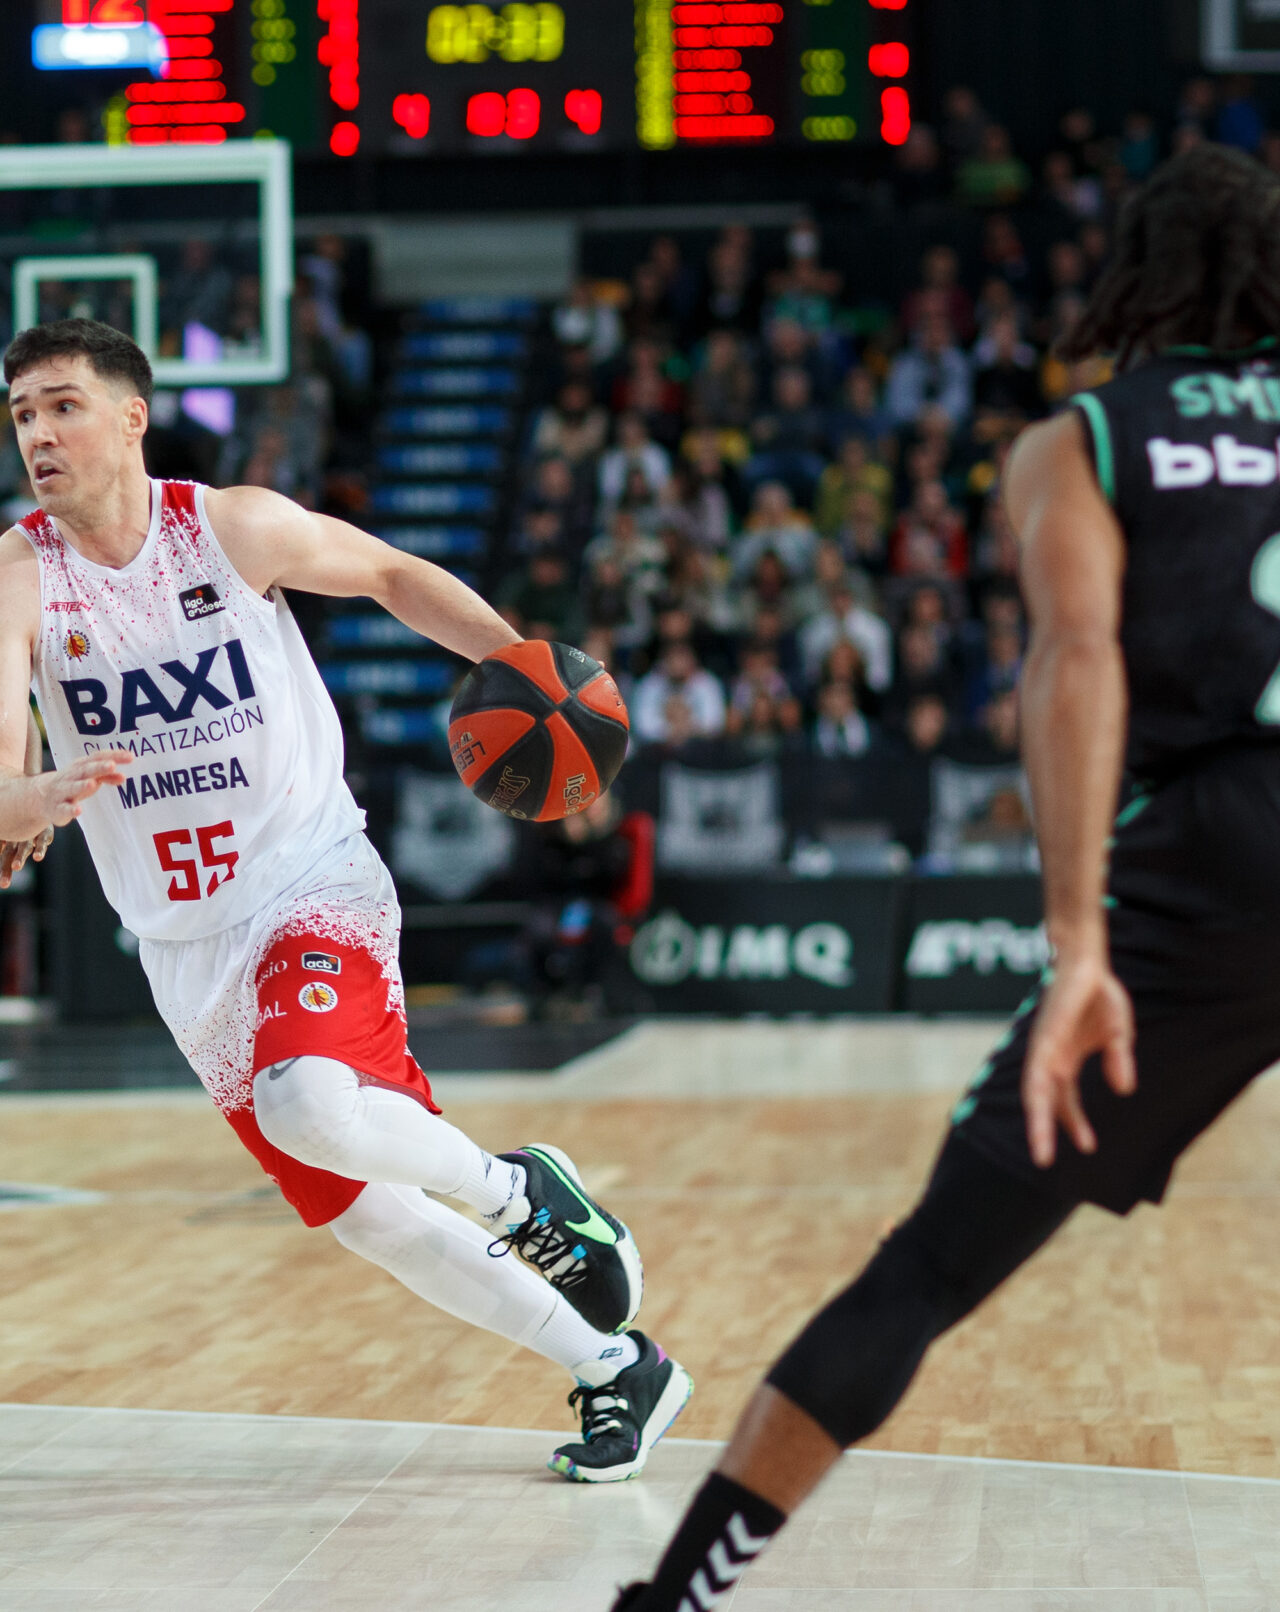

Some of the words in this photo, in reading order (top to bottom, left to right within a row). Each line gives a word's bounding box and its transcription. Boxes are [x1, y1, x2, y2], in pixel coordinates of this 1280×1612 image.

[1146, 434, 1280, 489] bb
[183, 596, 204, 609] liga
[187, 600, 226, 618] endesa
[58, 638, 257, 736] BAXI
[116, 757, 250, 810] MANRESA
[152, 820, 240, 901] 55
[305, 960, 333, 970] acb
[694, 922, 855, 988] IMQ
